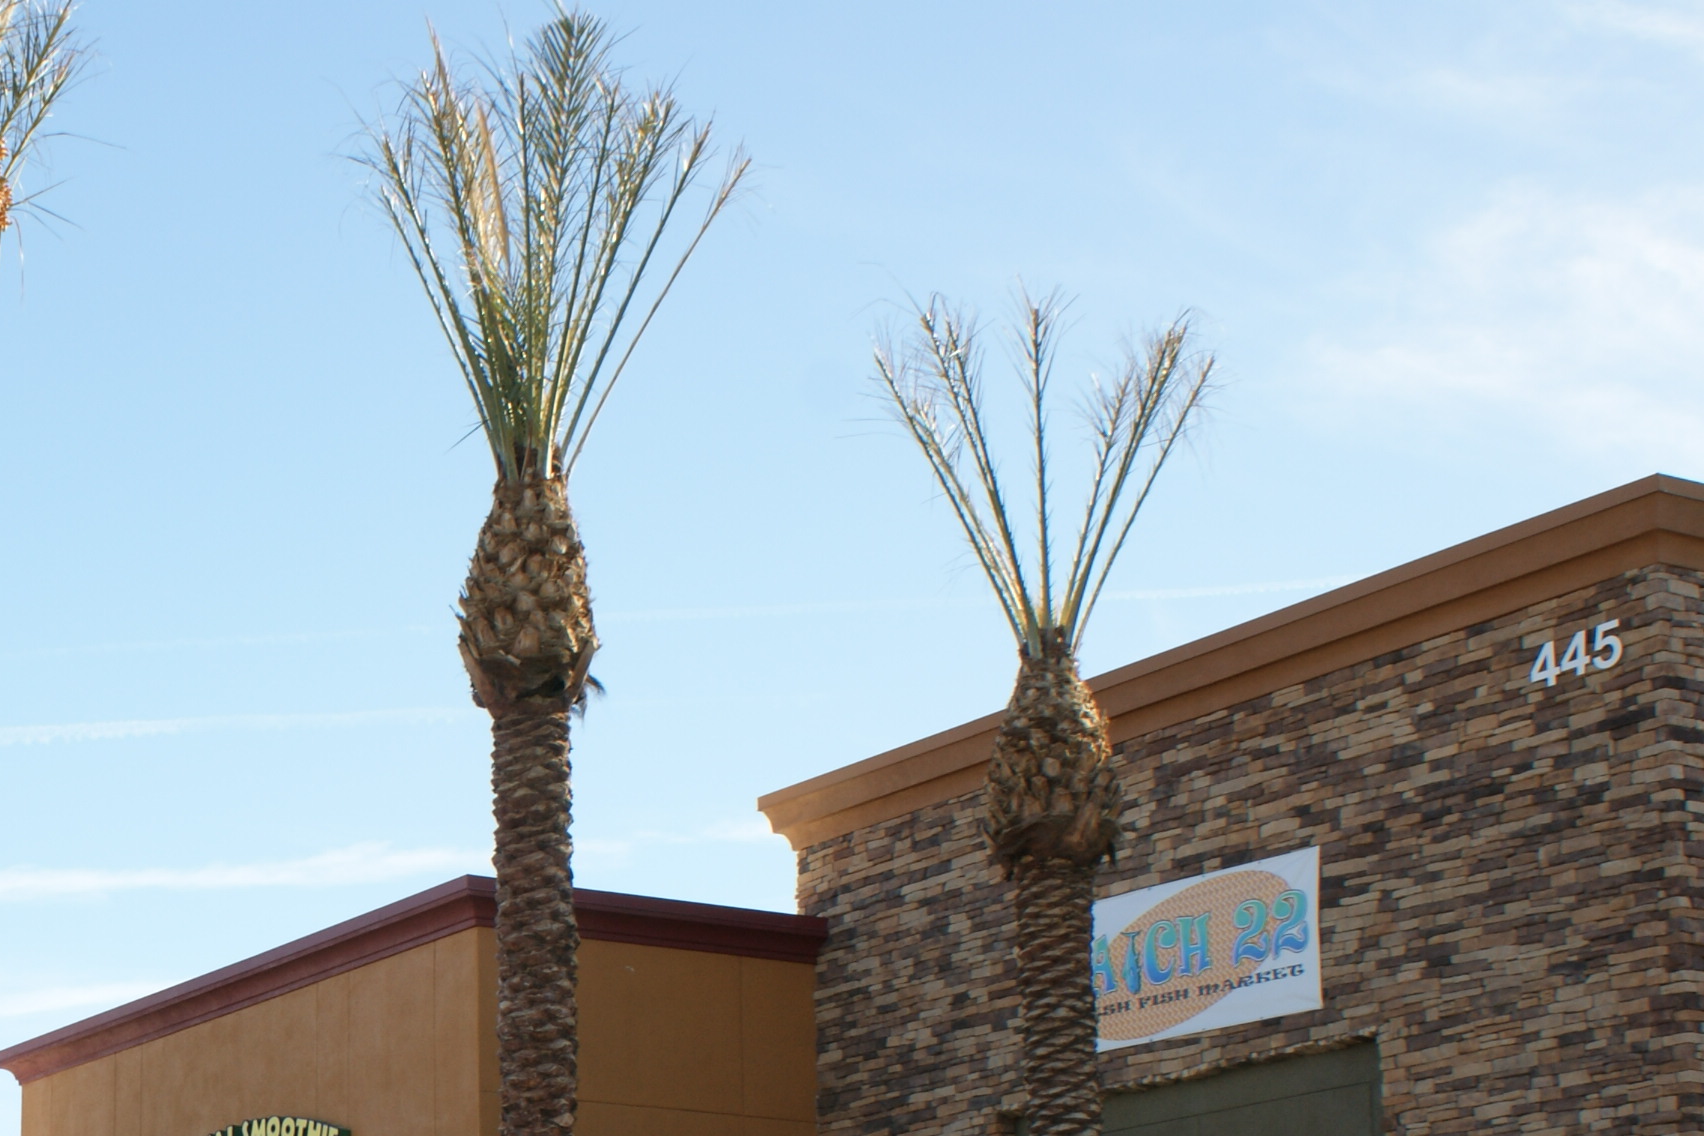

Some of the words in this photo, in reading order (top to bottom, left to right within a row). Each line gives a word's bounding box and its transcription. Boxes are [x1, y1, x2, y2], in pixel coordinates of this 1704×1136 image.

[1528, 618, 1624, 688] 445
[1091, 912, 1212, 999] ATCH
[1232, 889, 1310, 968] 22
[1137, 988, 1190, 1010] FISH
[1198, 963, 1305, 997] MARKET
